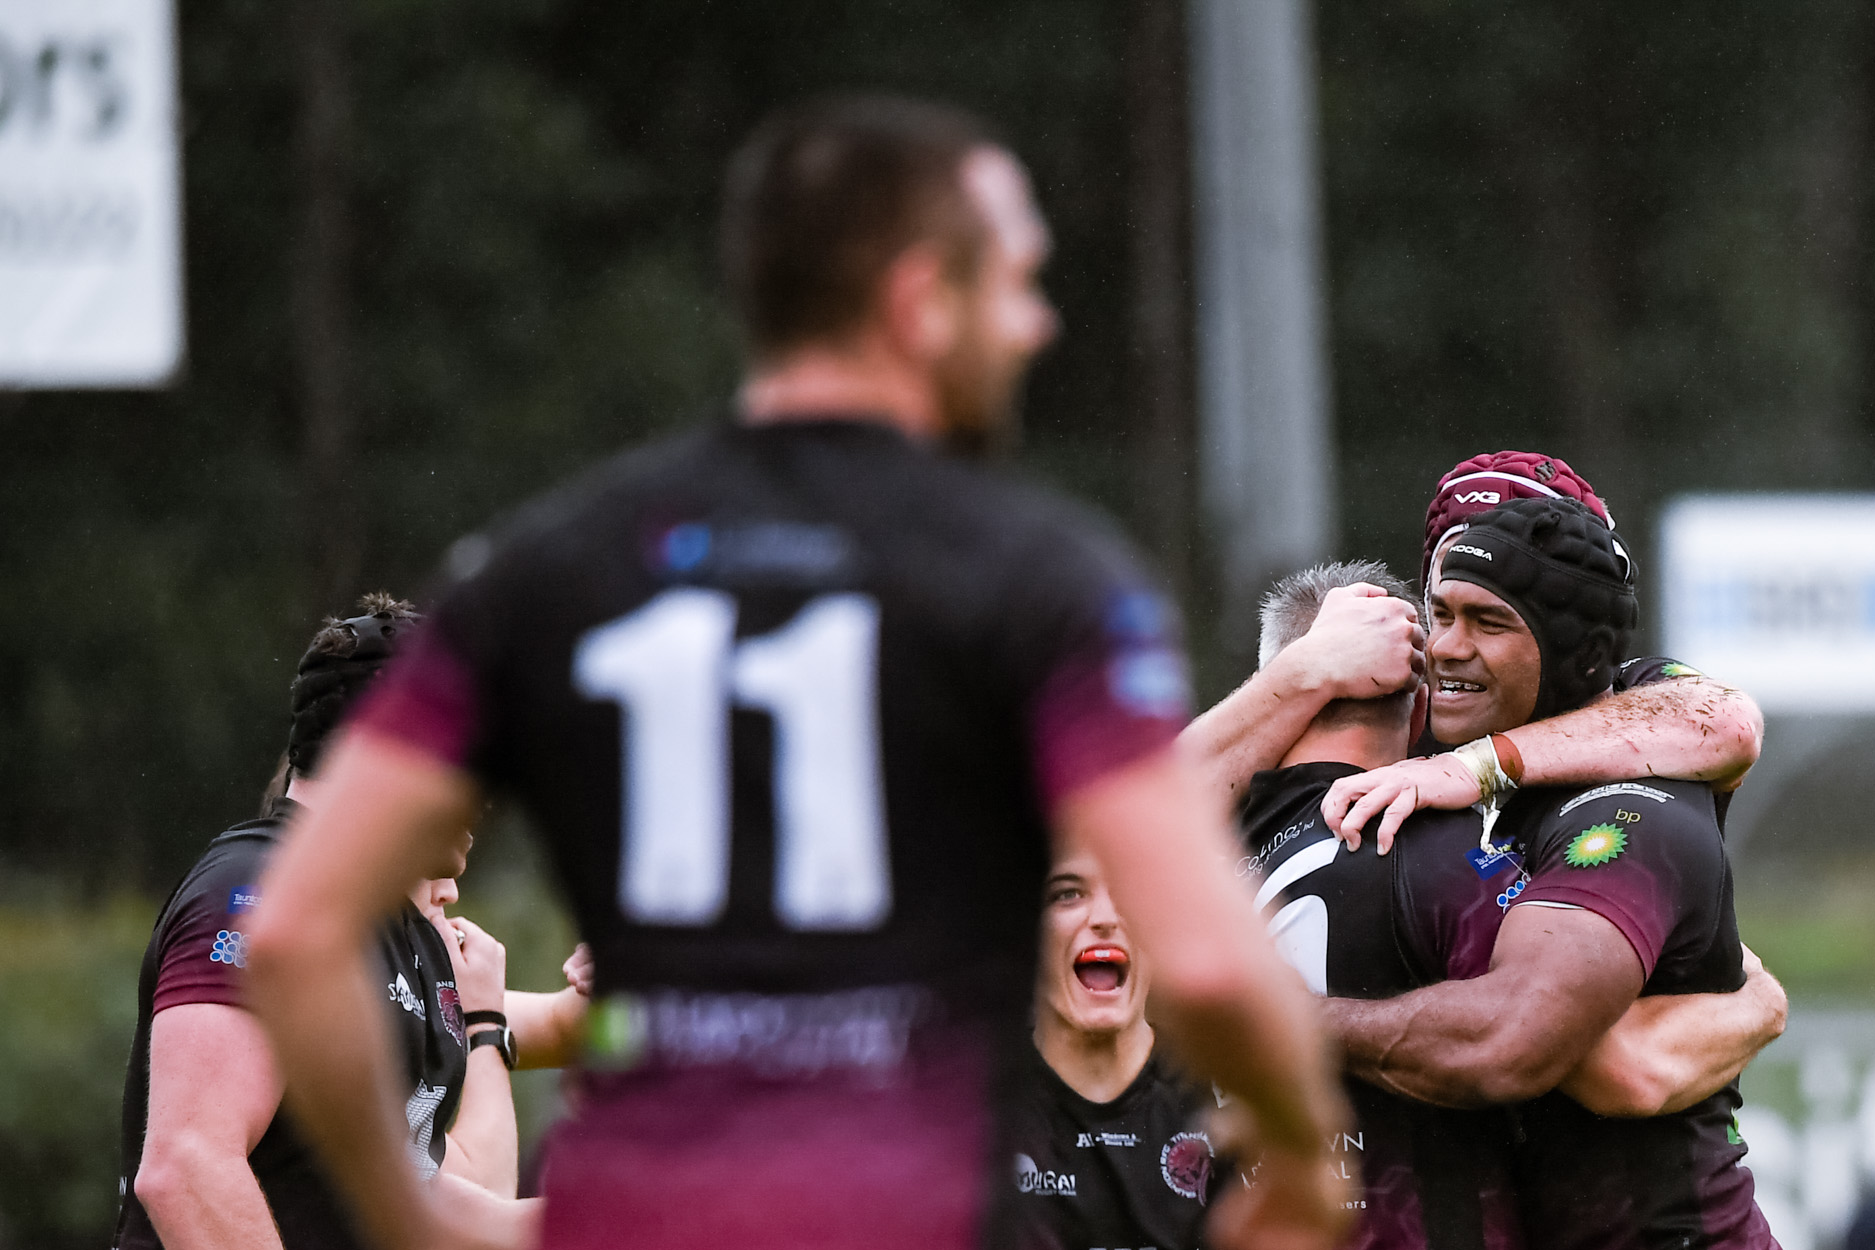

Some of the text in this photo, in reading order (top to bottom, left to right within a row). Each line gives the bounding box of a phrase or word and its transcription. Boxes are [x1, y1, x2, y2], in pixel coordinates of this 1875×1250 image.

[0, 30, 130, 145] rs
[1455, 491, 1500, 504] VX3
[1449, 545, 1492, 561] KOOGA
[571, 588, 893, 932] 11
[1615, 808, 1641, 823] bp
